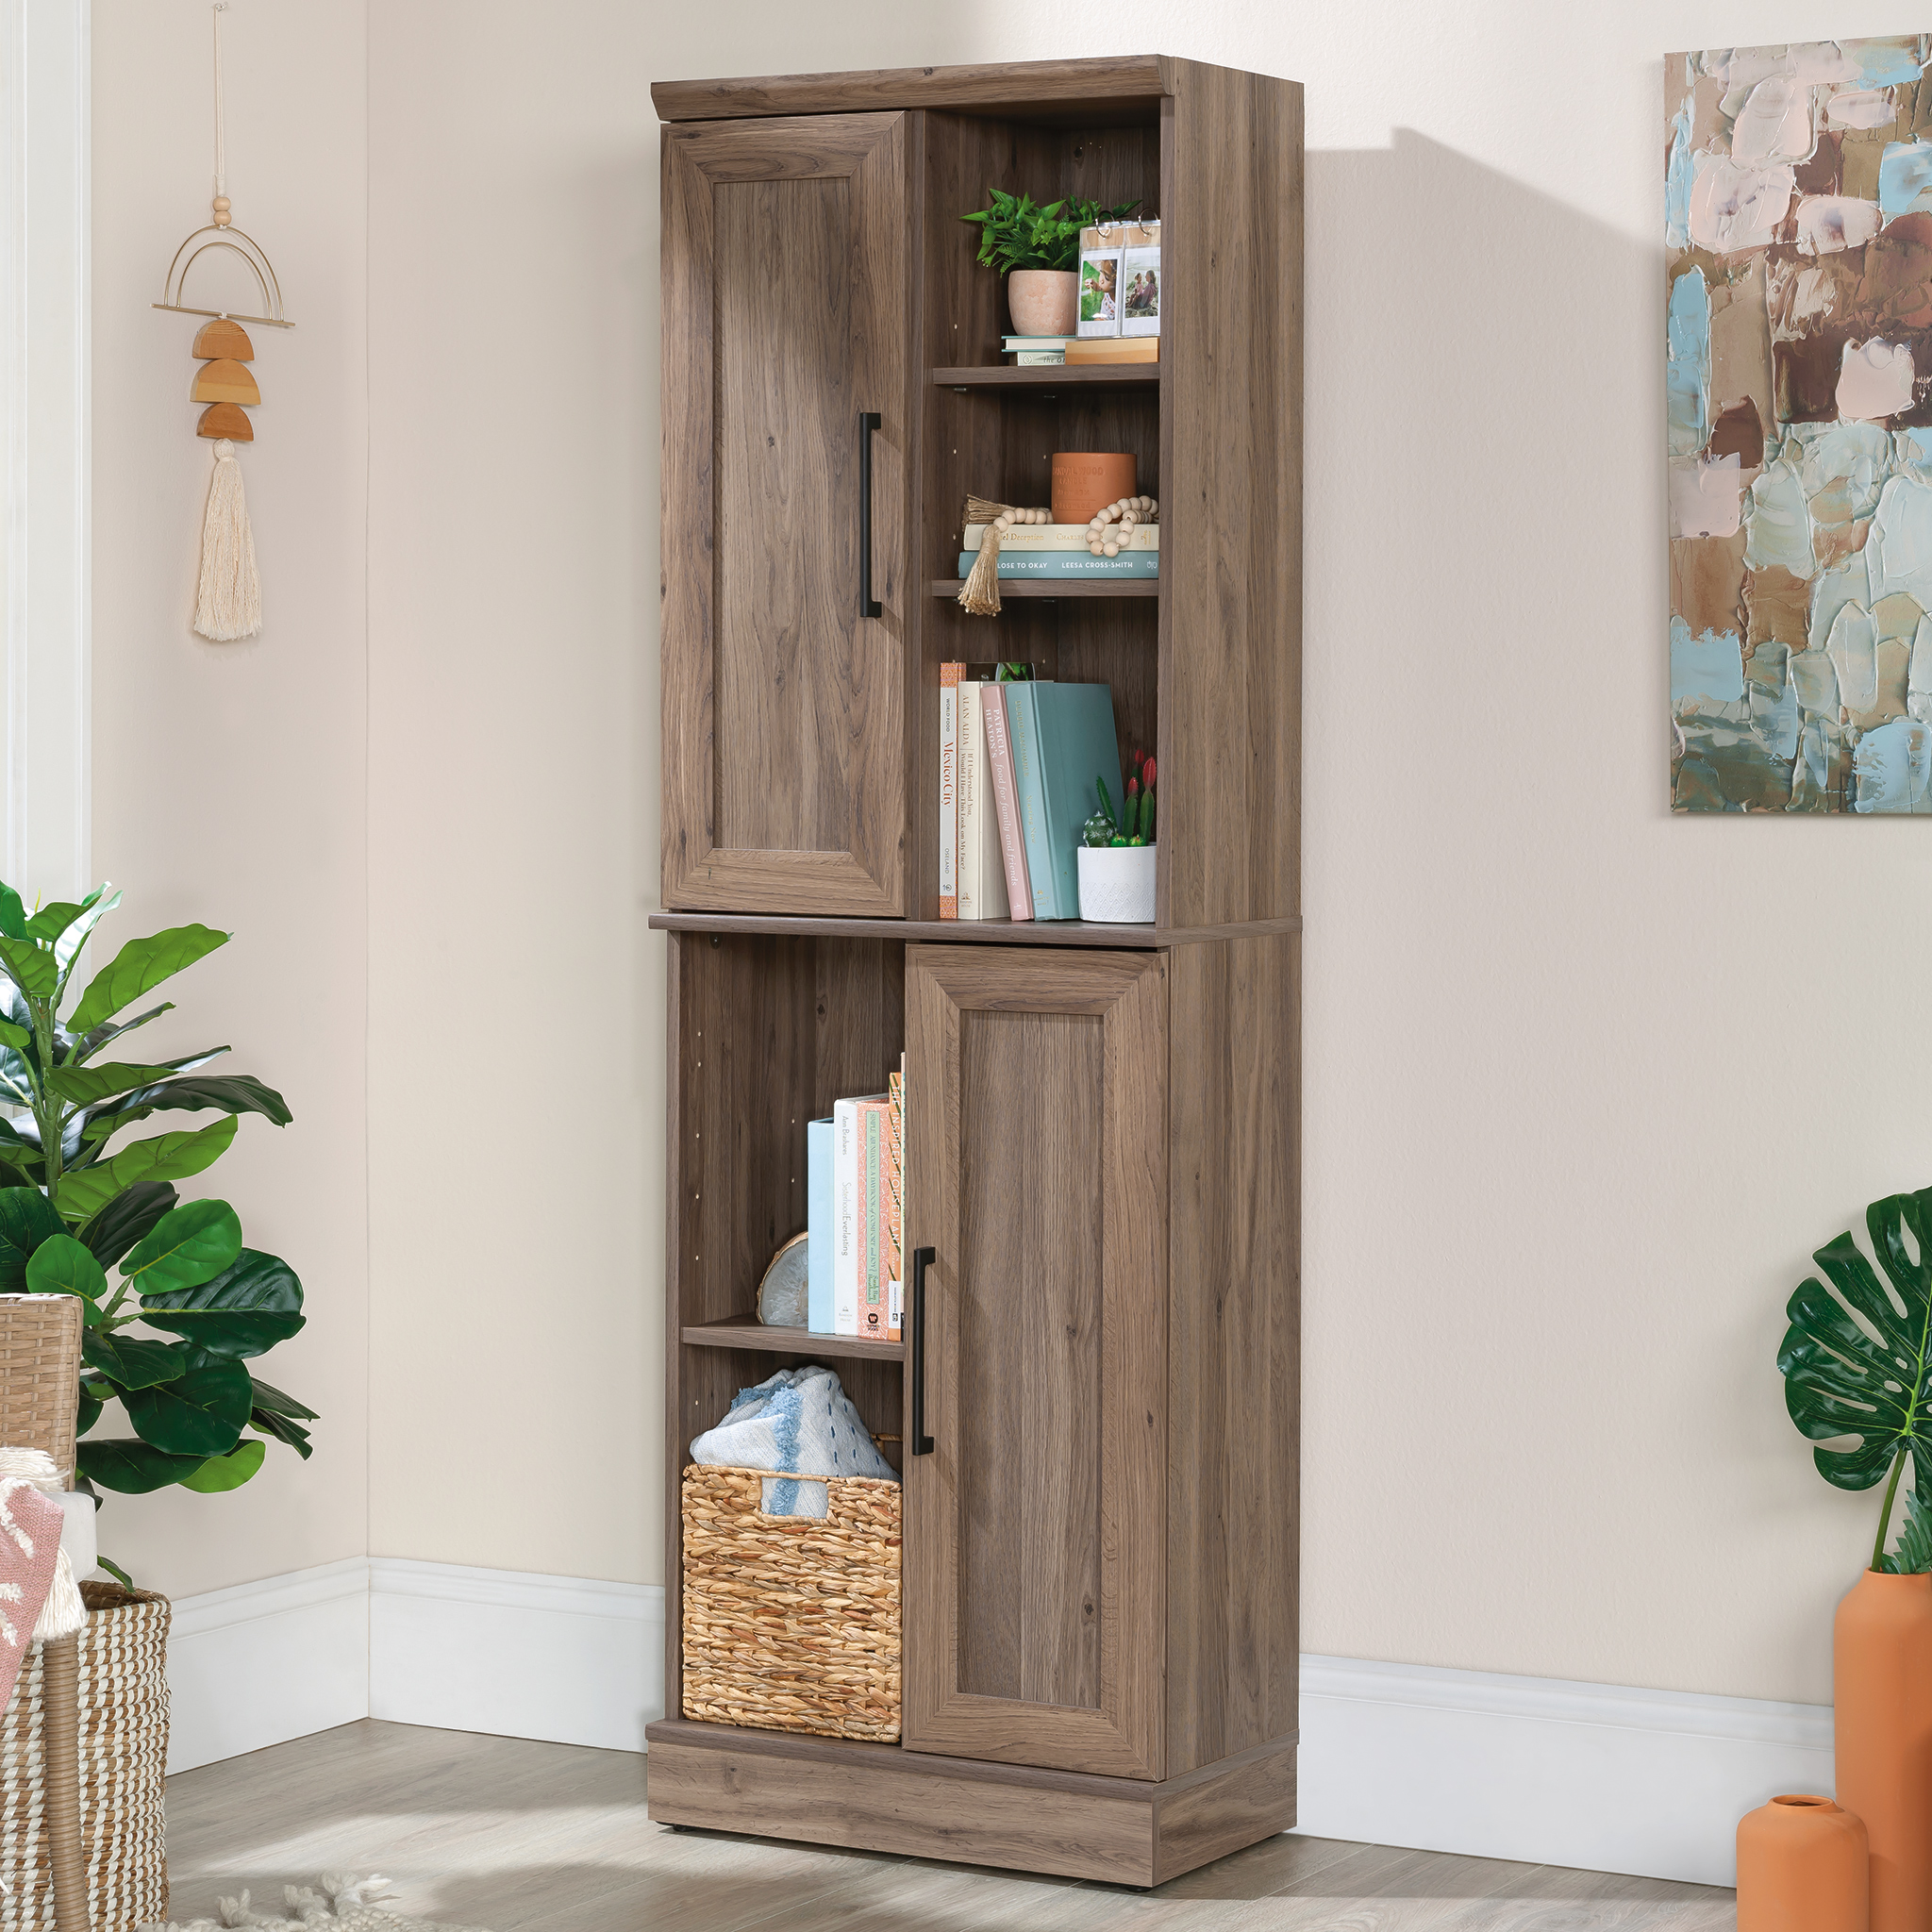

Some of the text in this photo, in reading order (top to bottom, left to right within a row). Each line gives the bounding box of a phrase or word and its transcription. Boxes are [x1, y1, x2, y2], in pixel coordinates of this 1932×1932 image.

[1010, 532, 1044, 542] Deception
[985, 708, 997, 758] HEATON'S
[993, 708, 1006, 756] PATRICIA
[1014, 700, 1029, 777] DEBBIE MACOMBER
[941, 741, 954, 808] Mexico City
[995, 762, 1019, 887] food for family and friends
[1025, 794, 1034, 825] Starting
[959, 841, 967, 851] My
[960, 830, 966, 840] on
[841, 1128, 850, 1156] Brashares
[891, 1086, 900, 1247] THE INSPIRED HOUSEPLANT
